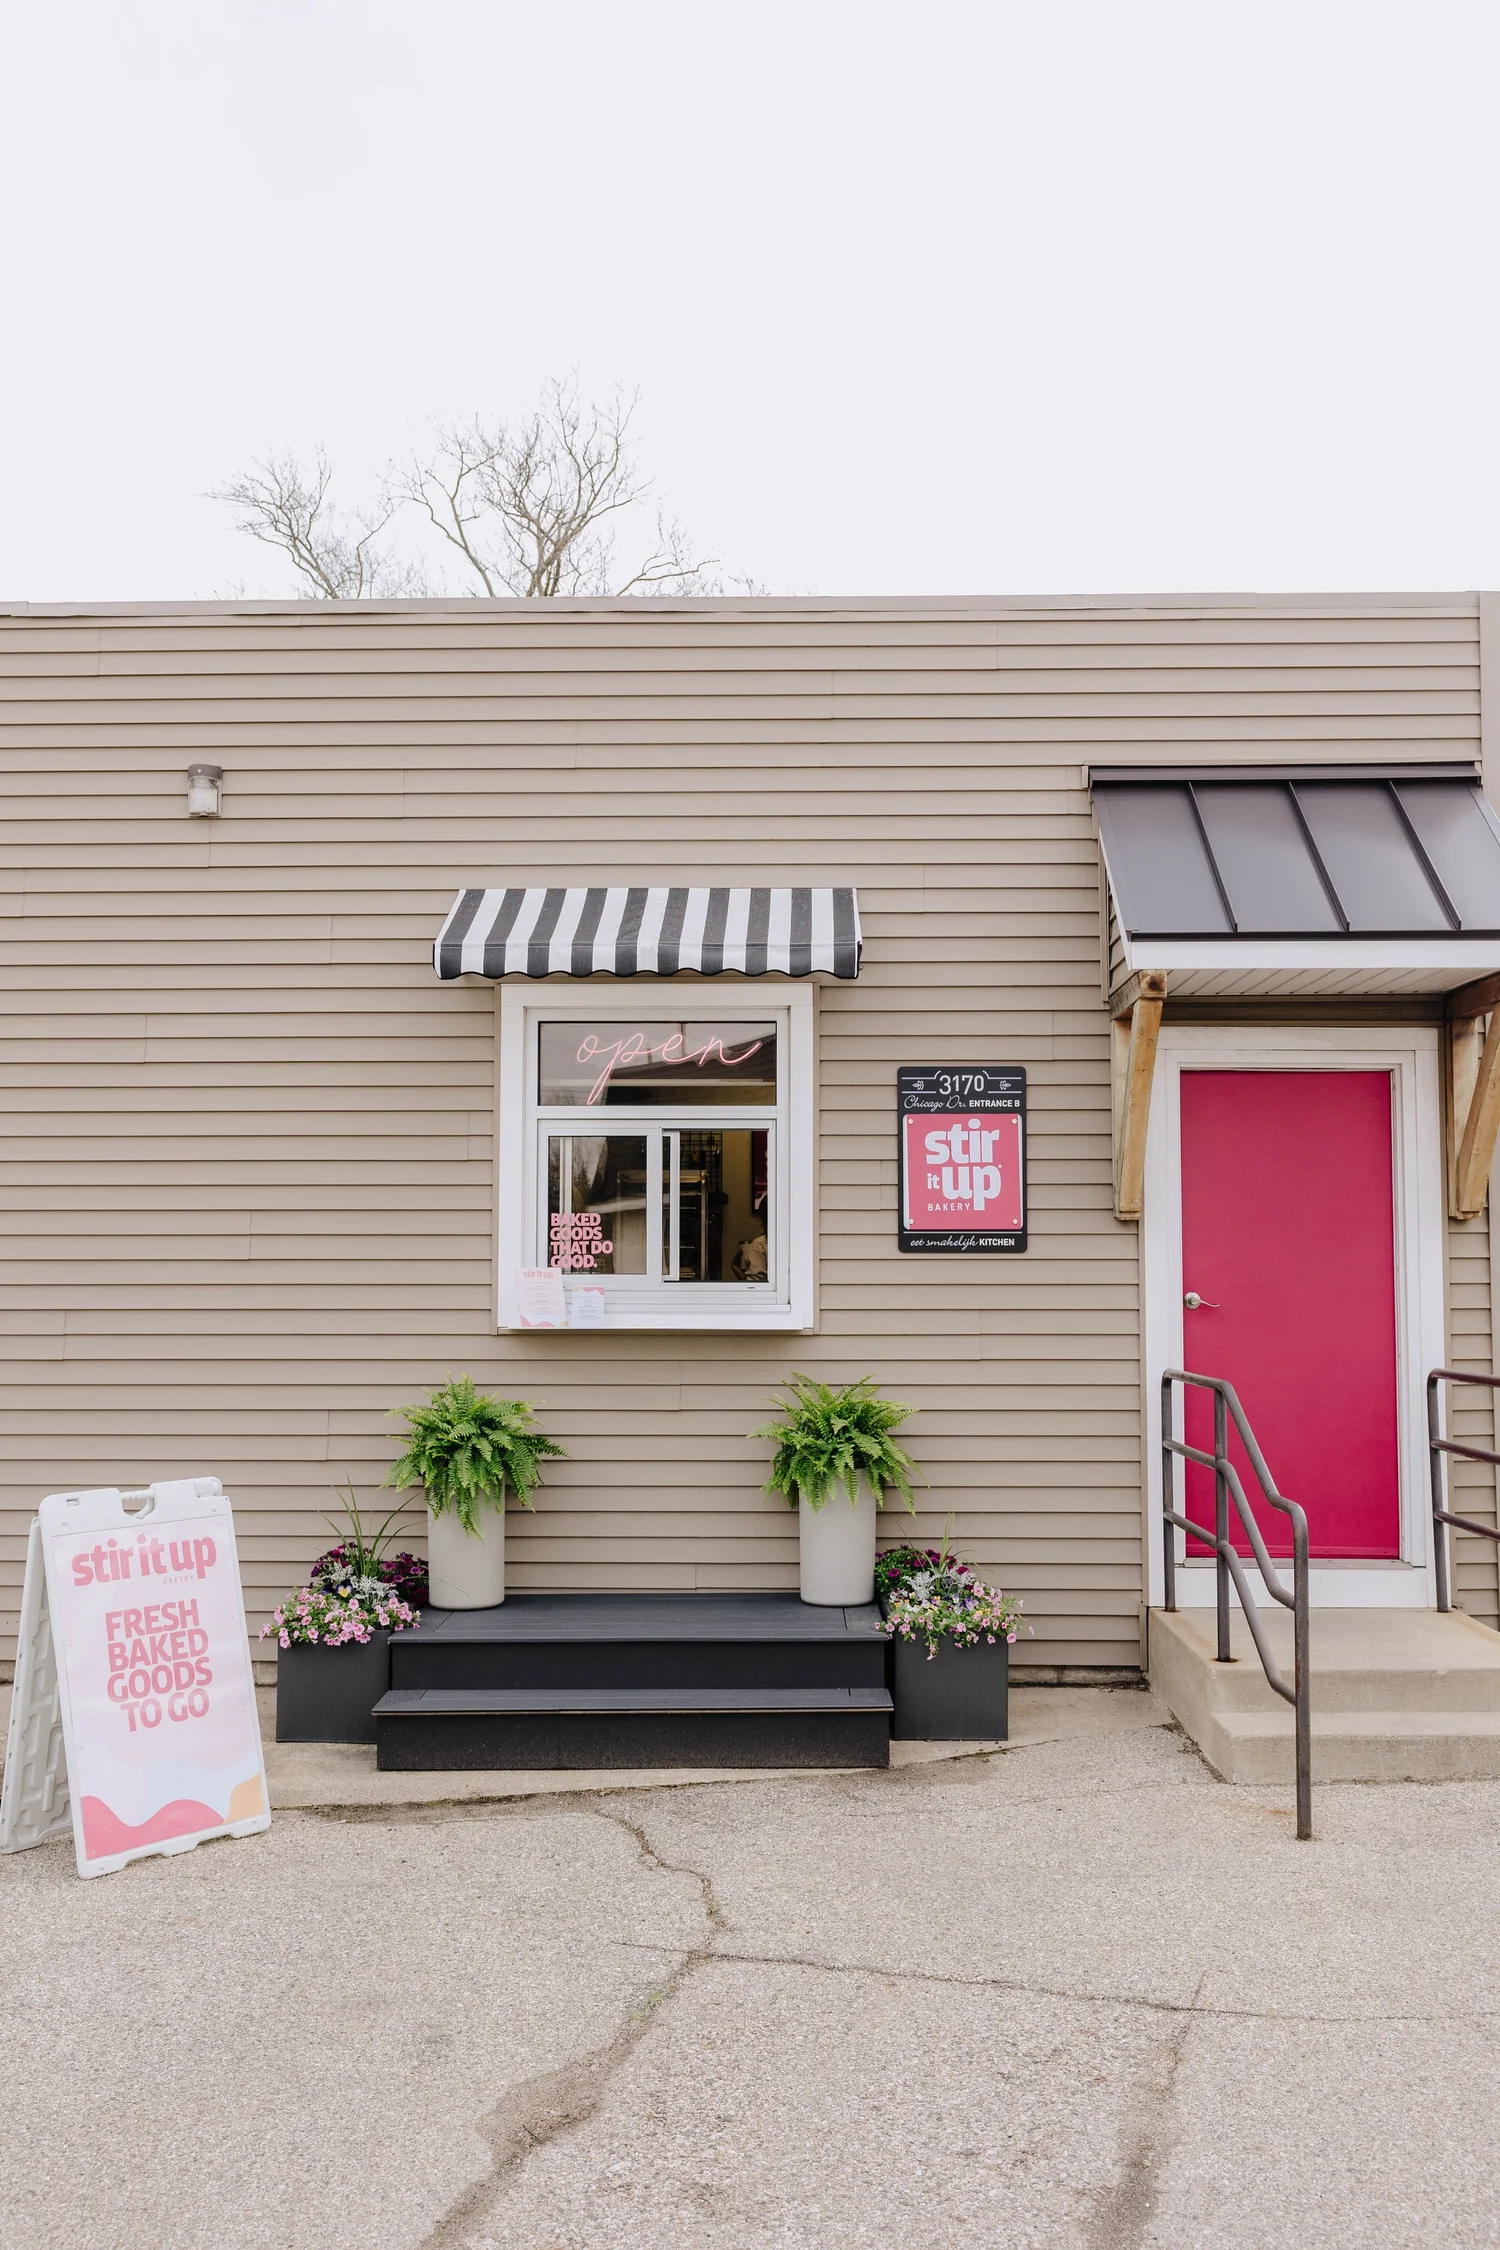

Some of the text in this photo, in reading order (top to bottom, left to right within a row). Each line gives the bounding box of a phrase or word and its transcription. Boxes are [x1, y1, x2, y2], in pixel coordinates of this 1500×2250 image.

[576, 1032, 762, 1106] open
[939, 1074, 985, 1095] 3170
[904, 1095, 1021, 1112] Chicago Dr. ENTRANCE B
[924, 1118, 1000, 1165] stir
[927, 1165, 1002, 1211] it up
[927, 1202, 970, 1212] BAKERY
[551, 1212, 602, 1227] BAKED
[550, 1226, 603, 1241] GOODS
[910, 1235, 1015, 1251] eet smakelijk KITCHEN
[550, 1240, 614, 1255] THAT DO
[550, 1254, 598, 1269] GOOD.
[71, 1534, 217, 1587] stir it up
[163, 1574, 194, 1586] BAKERY
[104, 1598, 200, 1642] FRESH
[107, 1628, 209, 1673] BAKED
[106, 1656, 213, 1703] GOODS
[120, 1688, 210, 1732] TO GO
